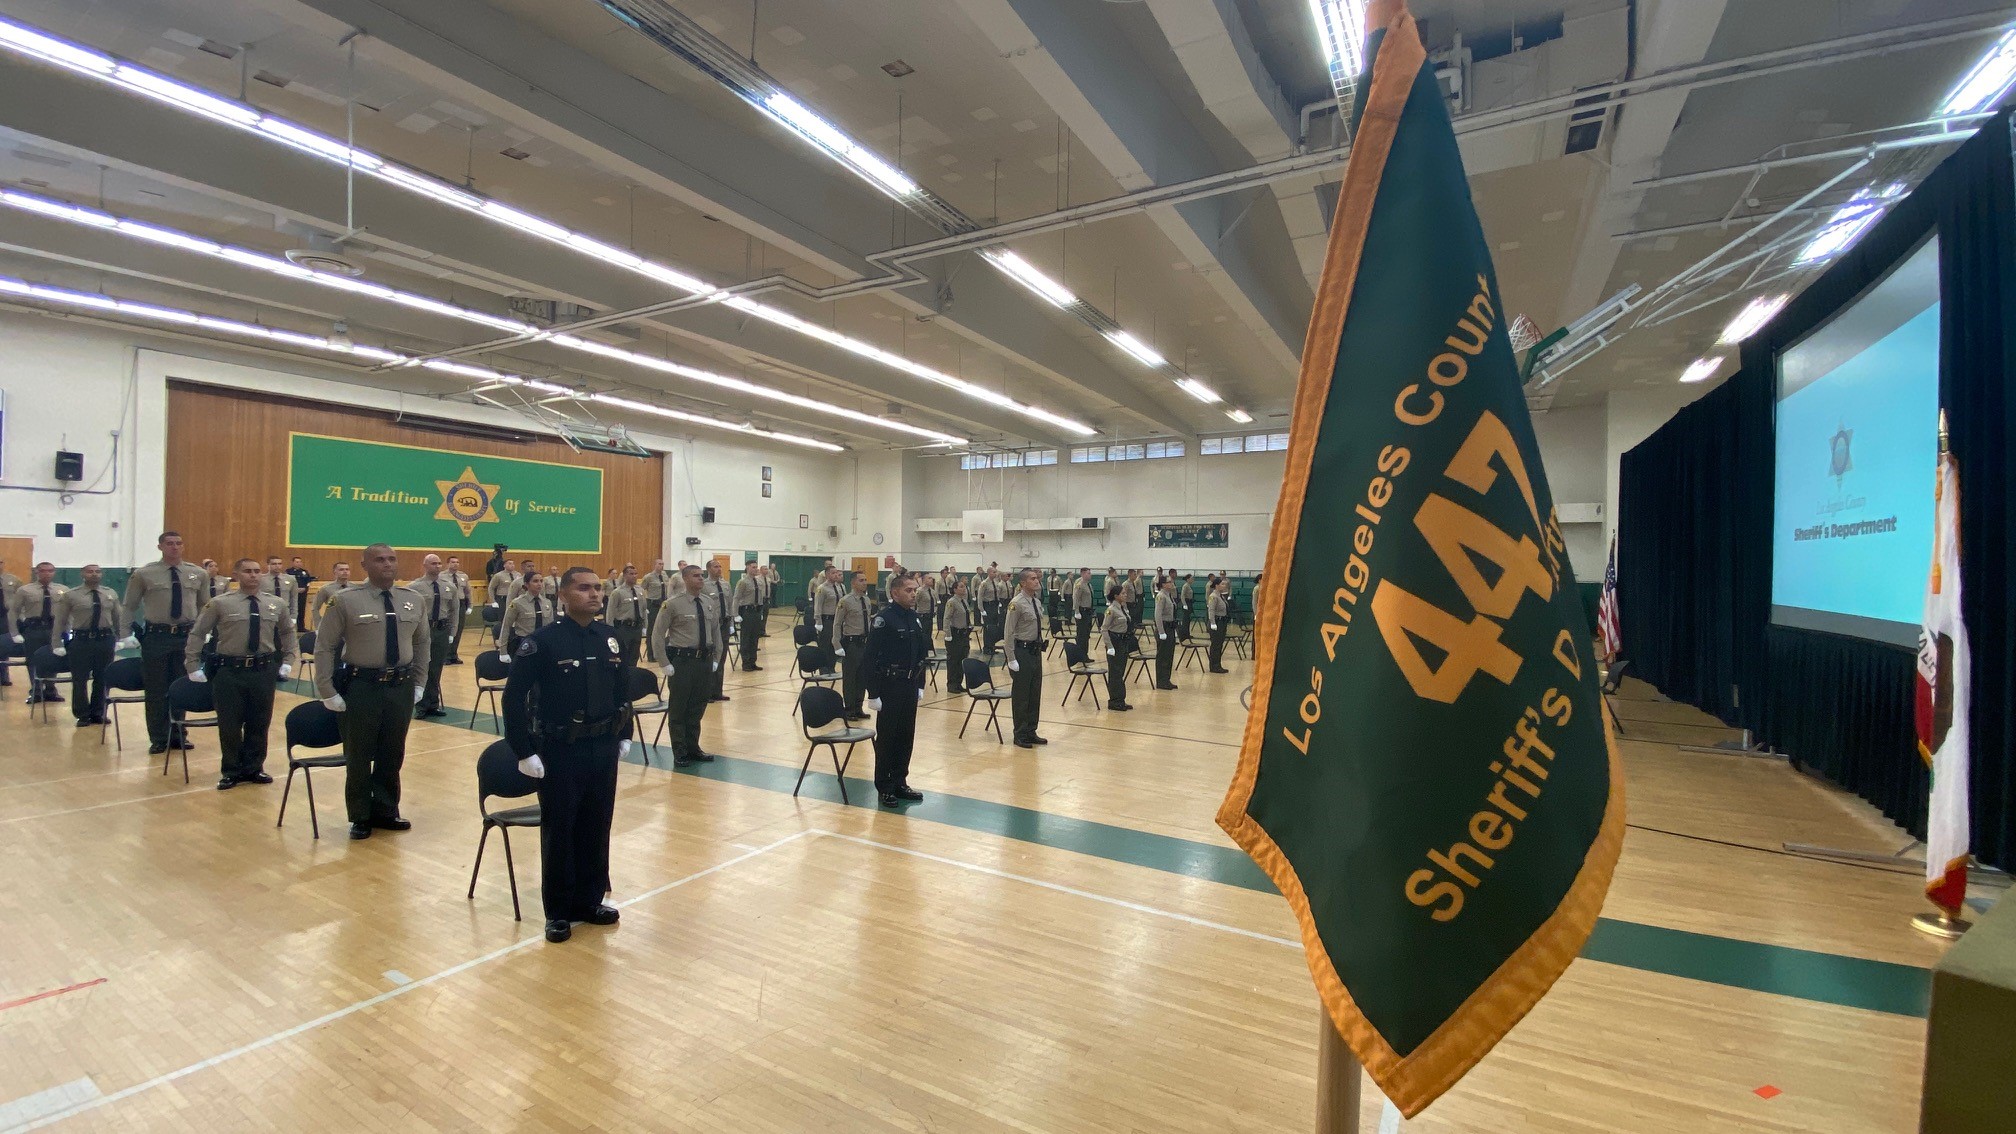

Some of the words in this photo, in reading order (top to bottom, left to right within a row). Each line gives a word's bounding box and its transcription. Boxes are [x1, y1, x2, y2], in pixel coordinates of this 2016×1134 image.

[325, 485, 343, 500] A
[350, 487, 429, 505] Tradition
[505, 498, 521, 516] Of
[528, 500, 577, 515] Service
[1283, 666, 1323, 756] Los
[1320, 444, 1411, 663] Angeles
[1371, 409, 1552, 704] 447
[1830, 515, 1897, 540] Department
[1404, 687, 1572, 922] Sheriff's
